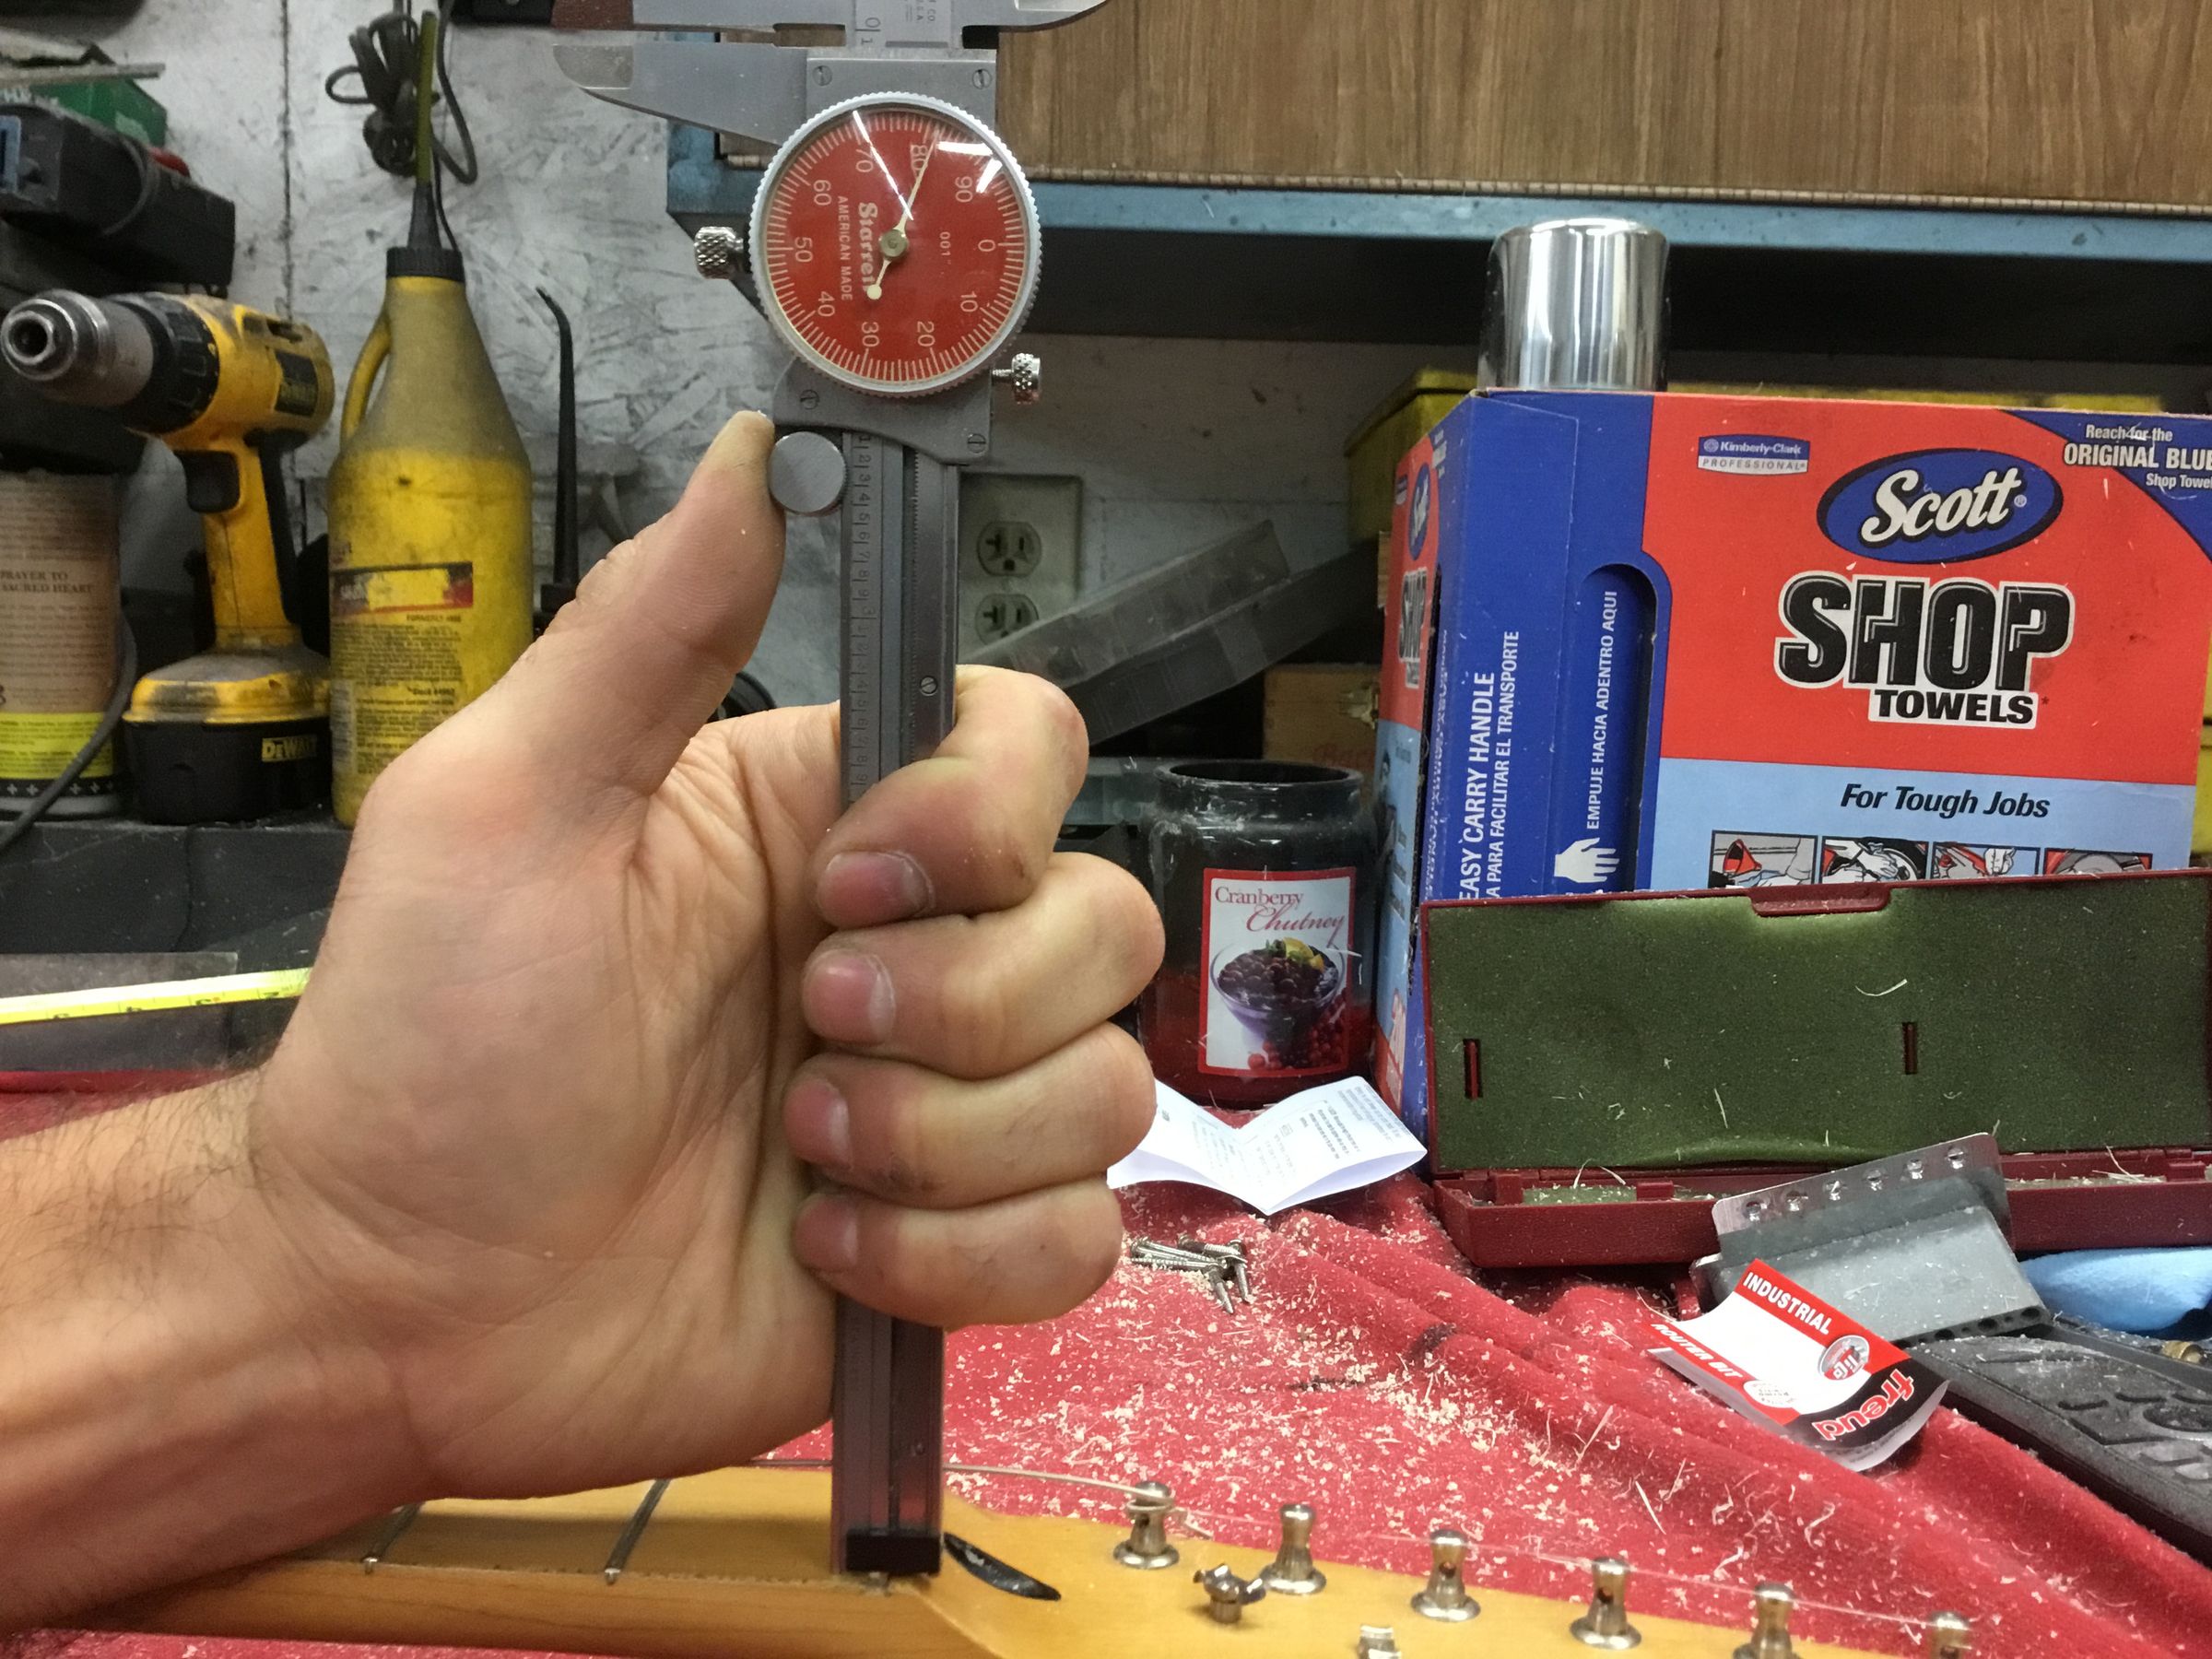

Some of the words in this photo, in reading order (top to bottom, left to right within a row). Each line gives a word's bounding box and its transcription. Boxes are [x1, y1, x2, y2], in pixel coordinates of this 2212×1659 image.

[855, 148, 875, 173] 70
[813, 179, 832, 206] 60
[955, 176, 973, 203] 90
[837, 195, 852, 261] AMERICAN
[977, 239, 996, 253] 0
[794, 236, 814, 264] 50
[840, 265, 853, 301] MADE
[959, 290, 979, 313] 10
[817, 290, 836, 317] 40
[861, 321, 880, 347] 30
[916, 321, 935, 347] 20
[2085, 424, 2126, 440] Reach
[2152, 428, 2174, 442] the
[2064, 442, 2160, 468] ORIGINAL
[2166, 447, 2212, 471] BLUE
[2146, 472, 2176, 490] Shop
[1860, 467, 2022, 543] Scott
[1603, 590, 1618, 632] AQUI
[1775, 571, 2074, 691] SHOP
[1497, 630, 1519, 735] TRANSPORTE
[1595, 634, 1614, 712] ADENTRO
[1468, 672, 1495, 762] HANDLE
[1875, 689, 2034, 724] TOWELS
[1495, 738, 1512, 757] EL
[1591, 713, 1607, 764] HACIA
[1463, 767, 1488, 843] CARRY
[1489, 759, 1510, 838] FACILITAR
[1586, 766, 1605, 830] EMPUJE
[1840, 782, 1888, 808] For
[1894, 785, 1979, 819] Tough
[1983, 791, 2050, 818] Jobs
[1459, 847, 1483, 900] EASY
[1487, 841, 1504, 882] PARA
[1215, 886, 1304, 910] Cranberry
[1246, 900, 1345, 950] Chutney
[1742, 1271, 1833, 1335] INDUSTRIAL
[1651, 1323, 1714, 1361] ROUTER
[1708, 1360, 1744, 1379] BIT
[1811, 1369, 1914, 1441] freud
